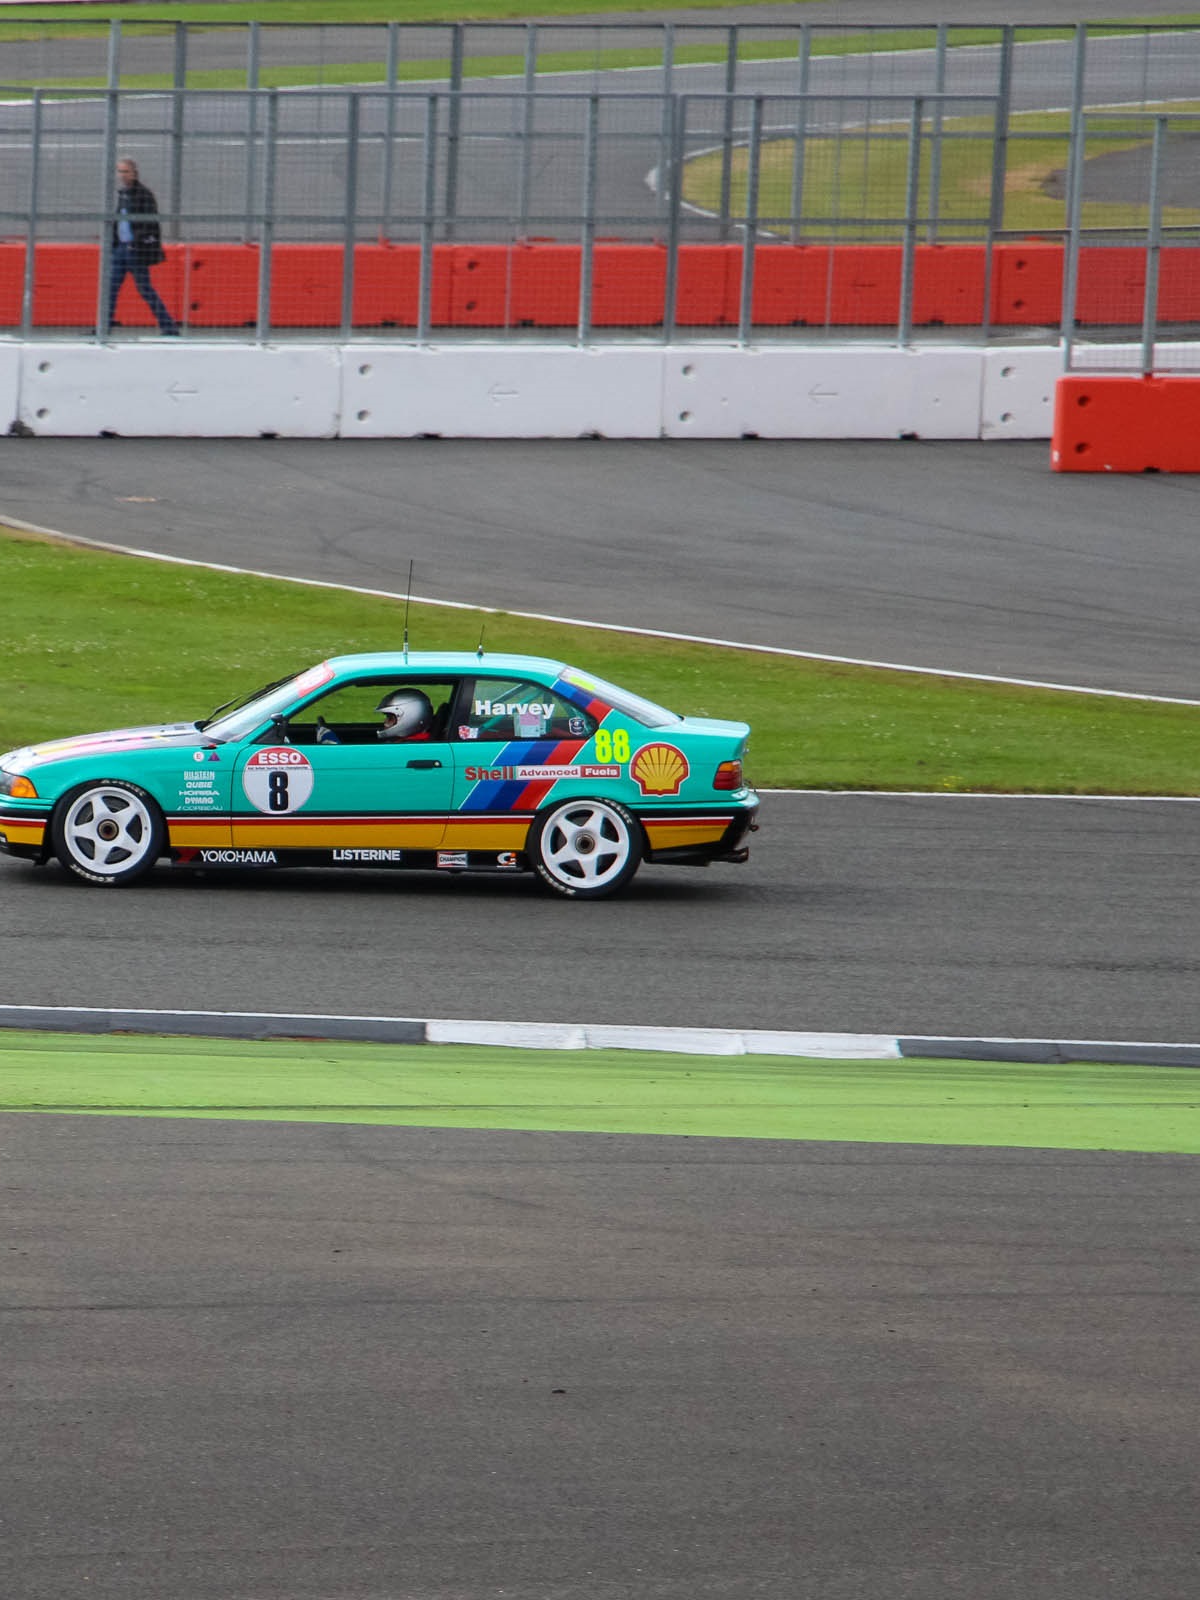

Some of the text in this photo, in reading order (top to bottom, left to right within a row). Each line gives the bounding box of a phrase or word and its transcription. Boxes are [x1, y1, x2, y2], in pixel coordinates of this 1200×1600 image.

[475, 700, 555, 720] Harvey
[595, 729, 631, 763] 88
[258, 752, 302, 764] ESSO
[465, 766, 618, 781] Shell Advanced Fuels
[268, 771, 289, 811] 8
[200, 850, 277, 863] YOKOHAMA
[333, 849, 401, 861] LISTERINE
